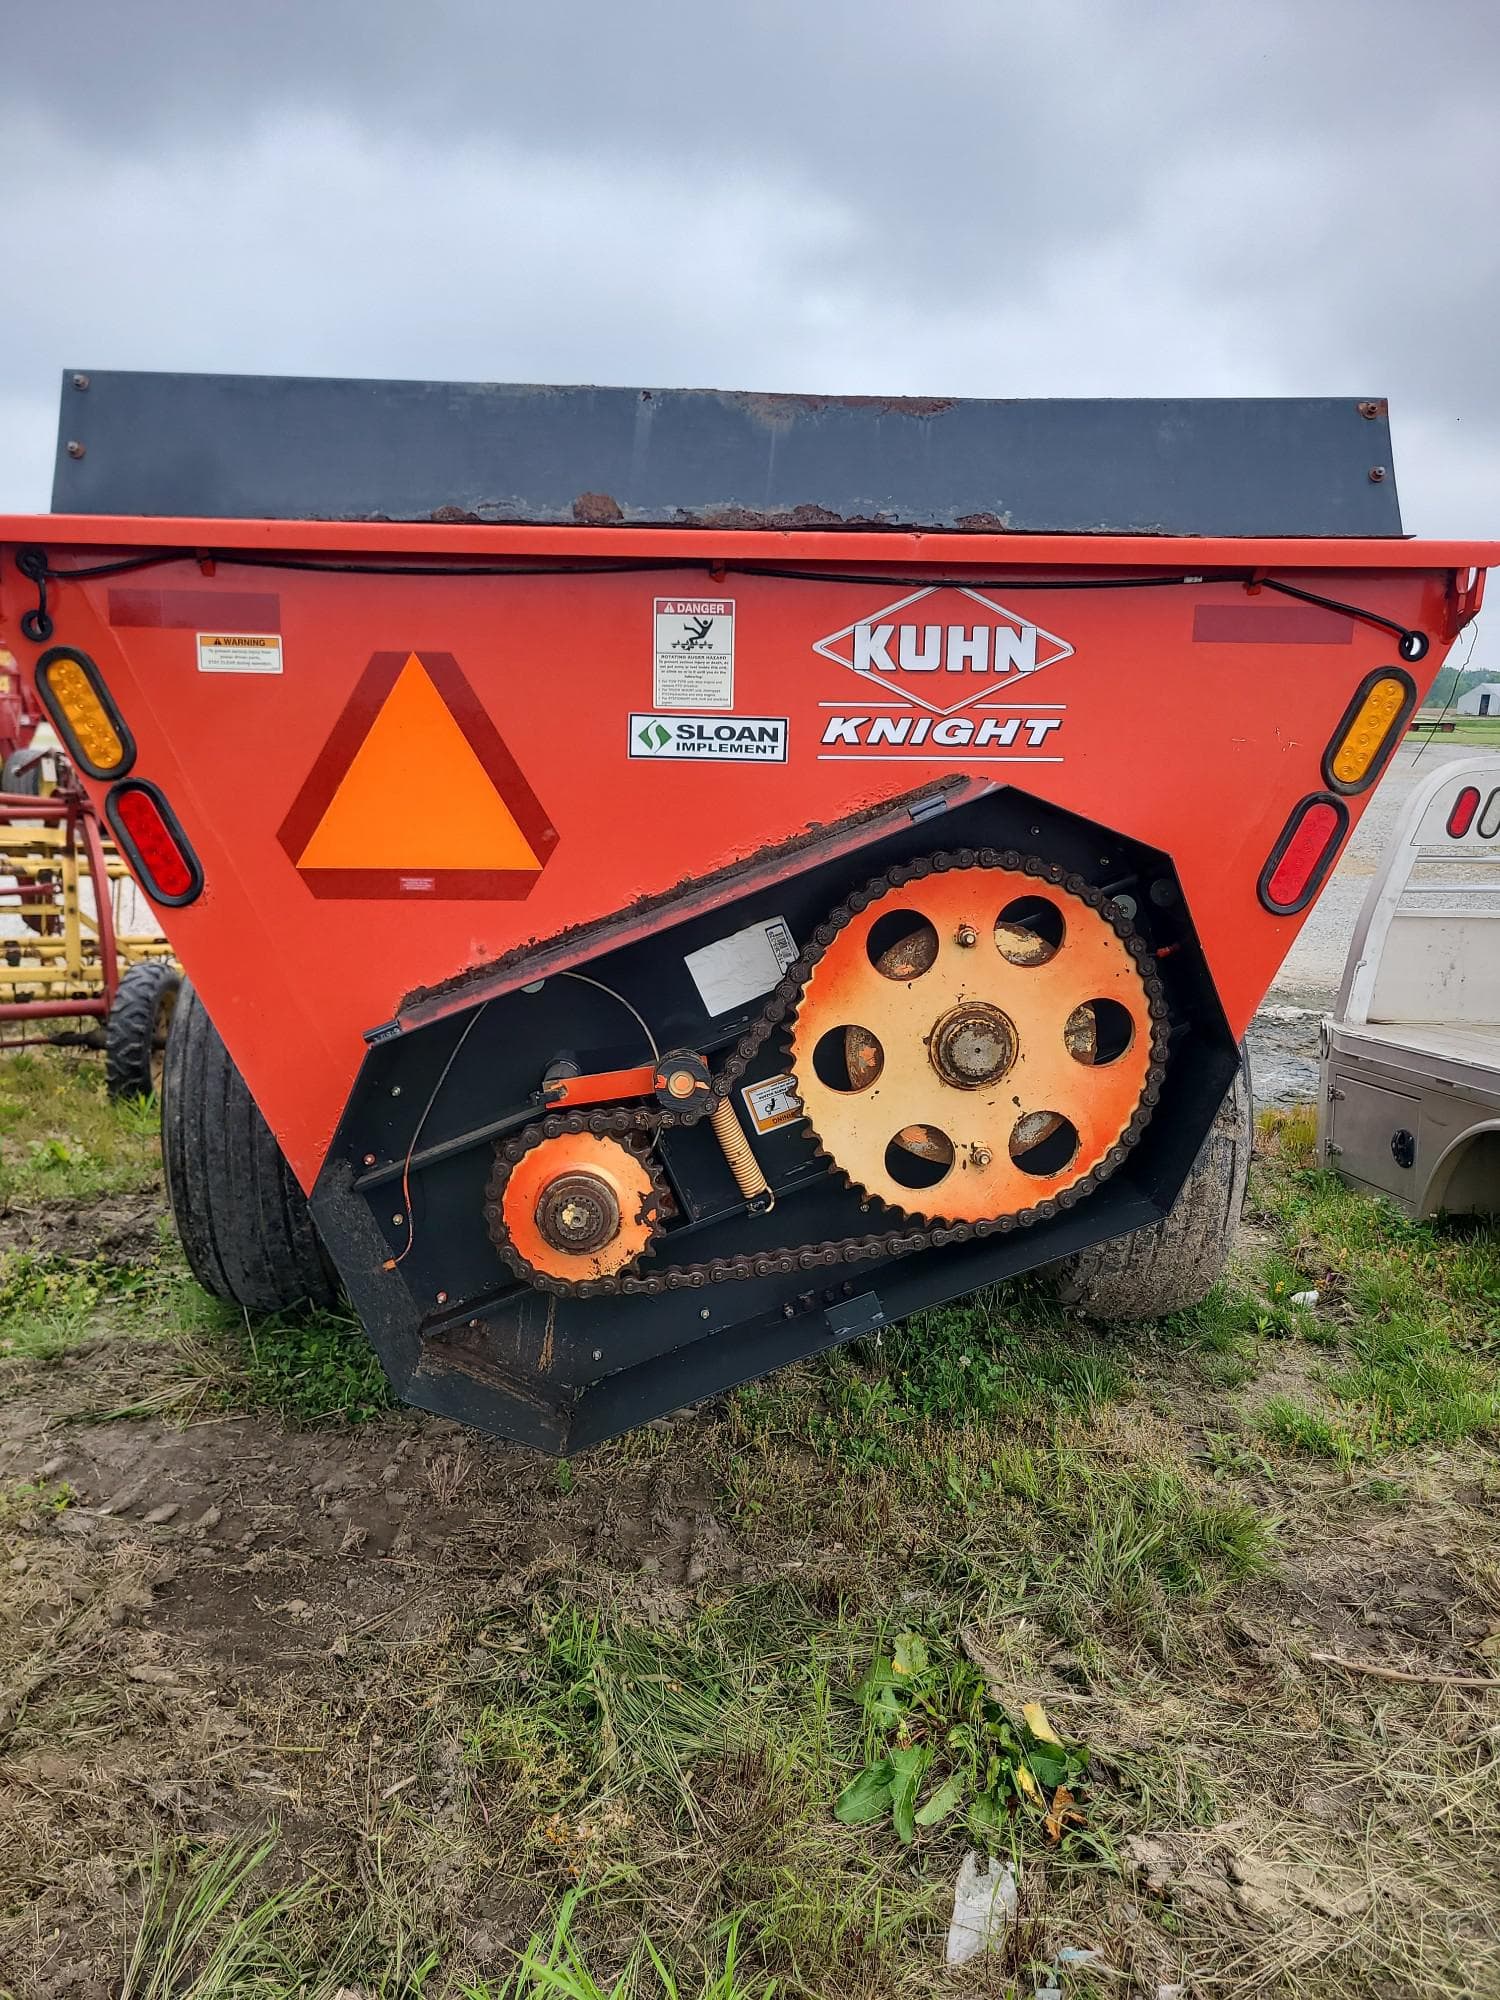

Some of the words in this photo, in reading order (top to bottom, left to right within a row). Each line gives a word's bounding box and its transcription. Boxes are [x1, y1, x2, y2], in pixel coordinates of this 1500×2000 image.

[677, 602, 725, 614] DANGER
[223, 638, 266, 647] WARNING
[853, 624, 1037, 672] KUHN
[676, 724, 779, 742] SLOAN
[820, 717, 1064, 747] KNIGHT
[676, 742, 779, 754] IMPLEMENT
